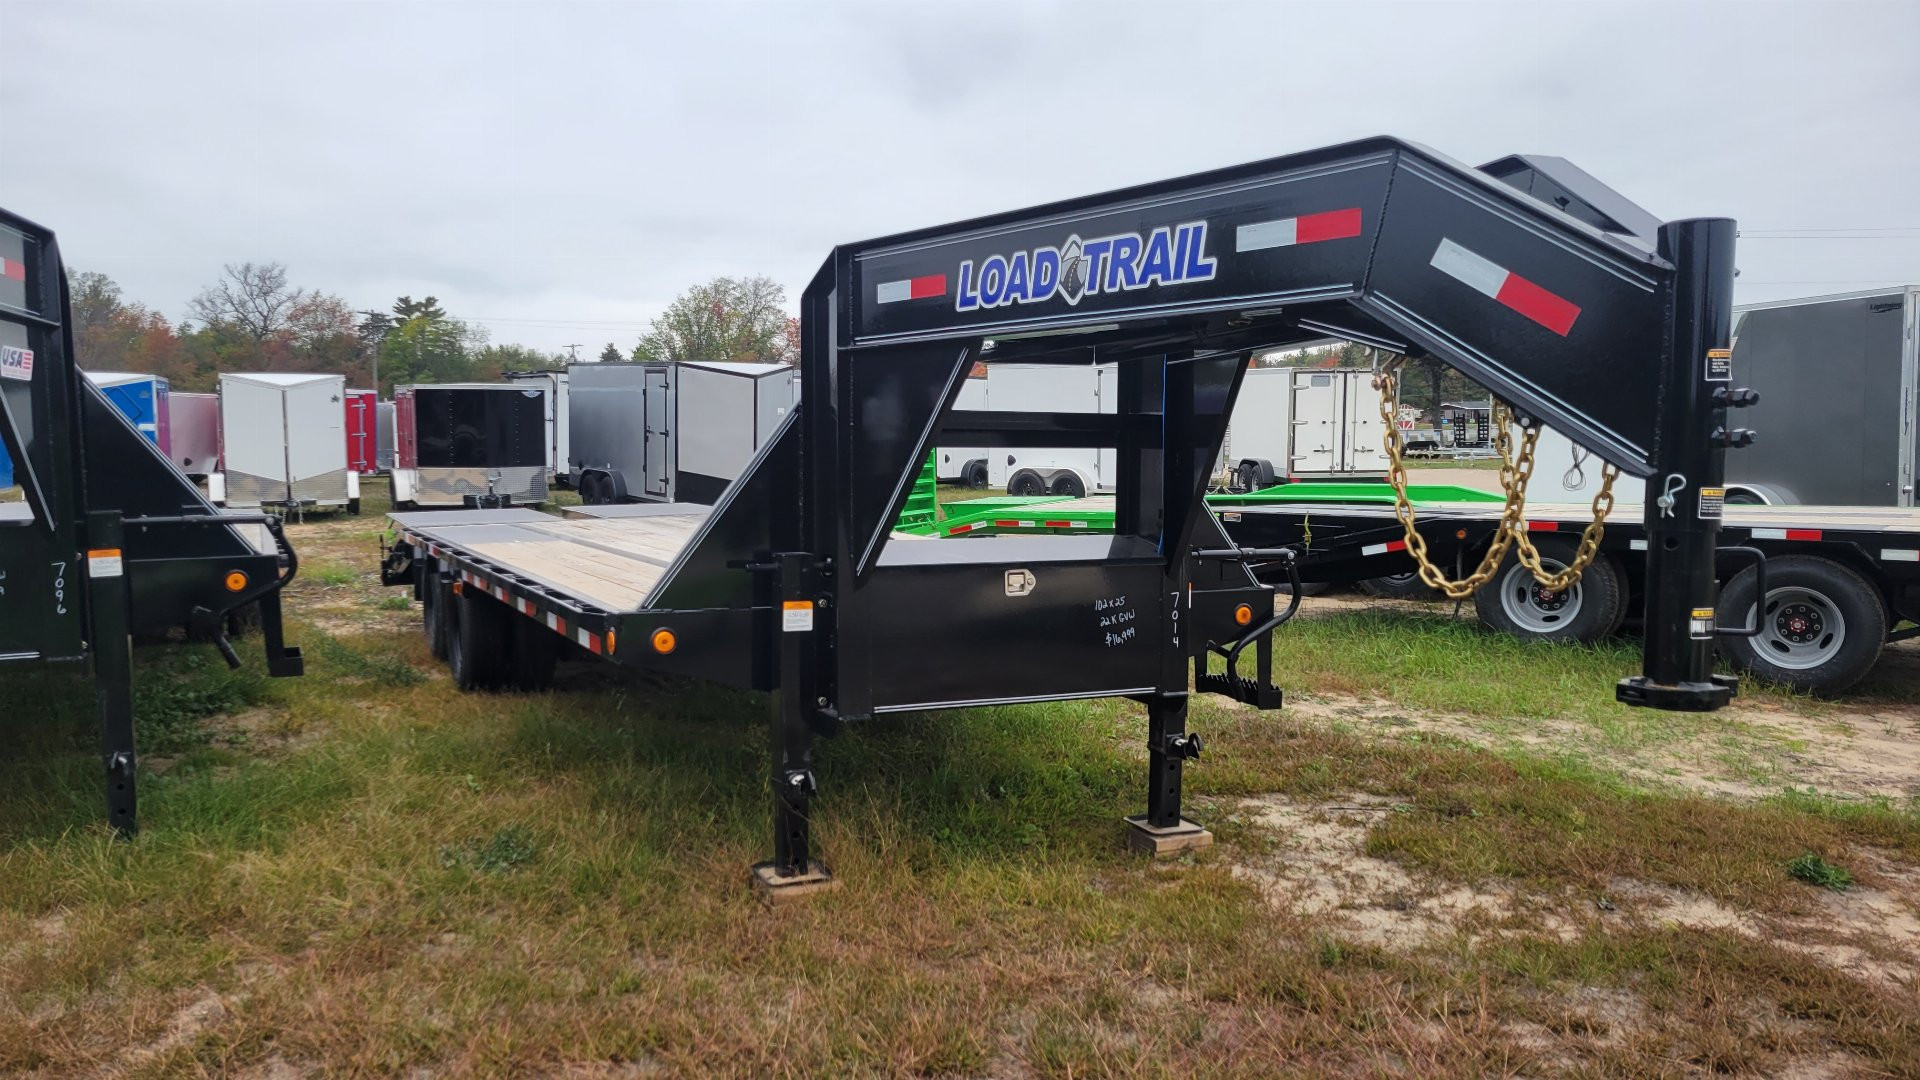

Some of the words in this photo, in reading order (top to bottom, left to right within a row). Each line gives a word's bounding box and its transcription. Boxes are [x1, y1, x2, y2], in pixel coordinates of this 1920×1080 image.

[956, 246, 1061, 311] LOAD
[1081, 220, 1217, 295] TRAIL
[2, 348, 23, 369] USA
[51, 561, 67, 614] 7096
[1118, 609, 1136, 623] GVW
[1170, 591, 1180, 648] 7014
[1105, 626, 1135, 648] $16,999
